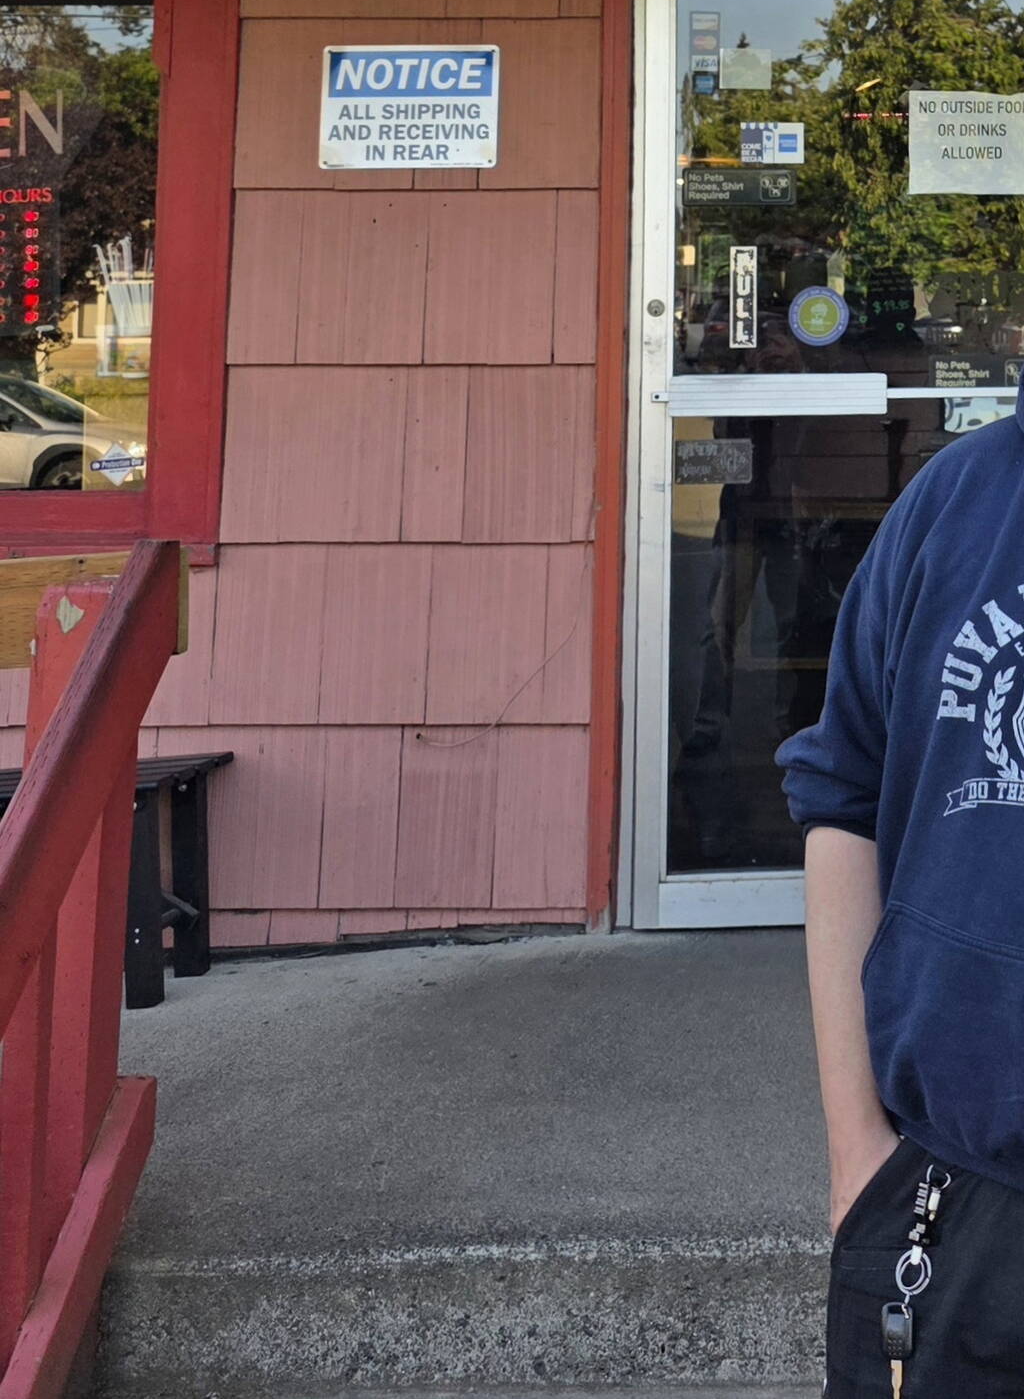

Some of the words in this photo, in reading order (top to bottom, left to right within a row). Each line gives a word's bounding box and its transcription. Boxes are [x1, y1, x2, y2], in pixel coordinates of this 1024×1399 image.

[695, 57, 717, 68] VISA
[335, 58, 487, 90] NOTICE
[338, 104, 376, 120] ALL
[381, 103, 481, 120] SHIPPING
[919, 101, 936, 114] NO
[941, 101, 993, 114] OUTSIDE
[328, 124, 371, 141] AND
[378, 123, 490, 140] RECEIVING
[938, 123, 955, 137] OR
[959, 123, 1007, 137] DRINKS
[365, 145, 385, 161] IN
[393, 144, 450, 161] REAR
[941, 146, 1003, 160] ALLOWED
[688, 173, 701, 182] No
[703, 173, 725, 182] Pets
[688, 182, 720, 192] Shoes,
[721, 182, 745, 191] Shirt
[0, 187, 53, 204] OURS
[688, 191, 730, 201] Required
[935, 361, 948, 370] No
[950, 361, 970, 370] Pets
[935, 370, 967, 379] Shoes,
[968, 370, 990, 379] Shirt
[935, 379, 977, 387] Required
